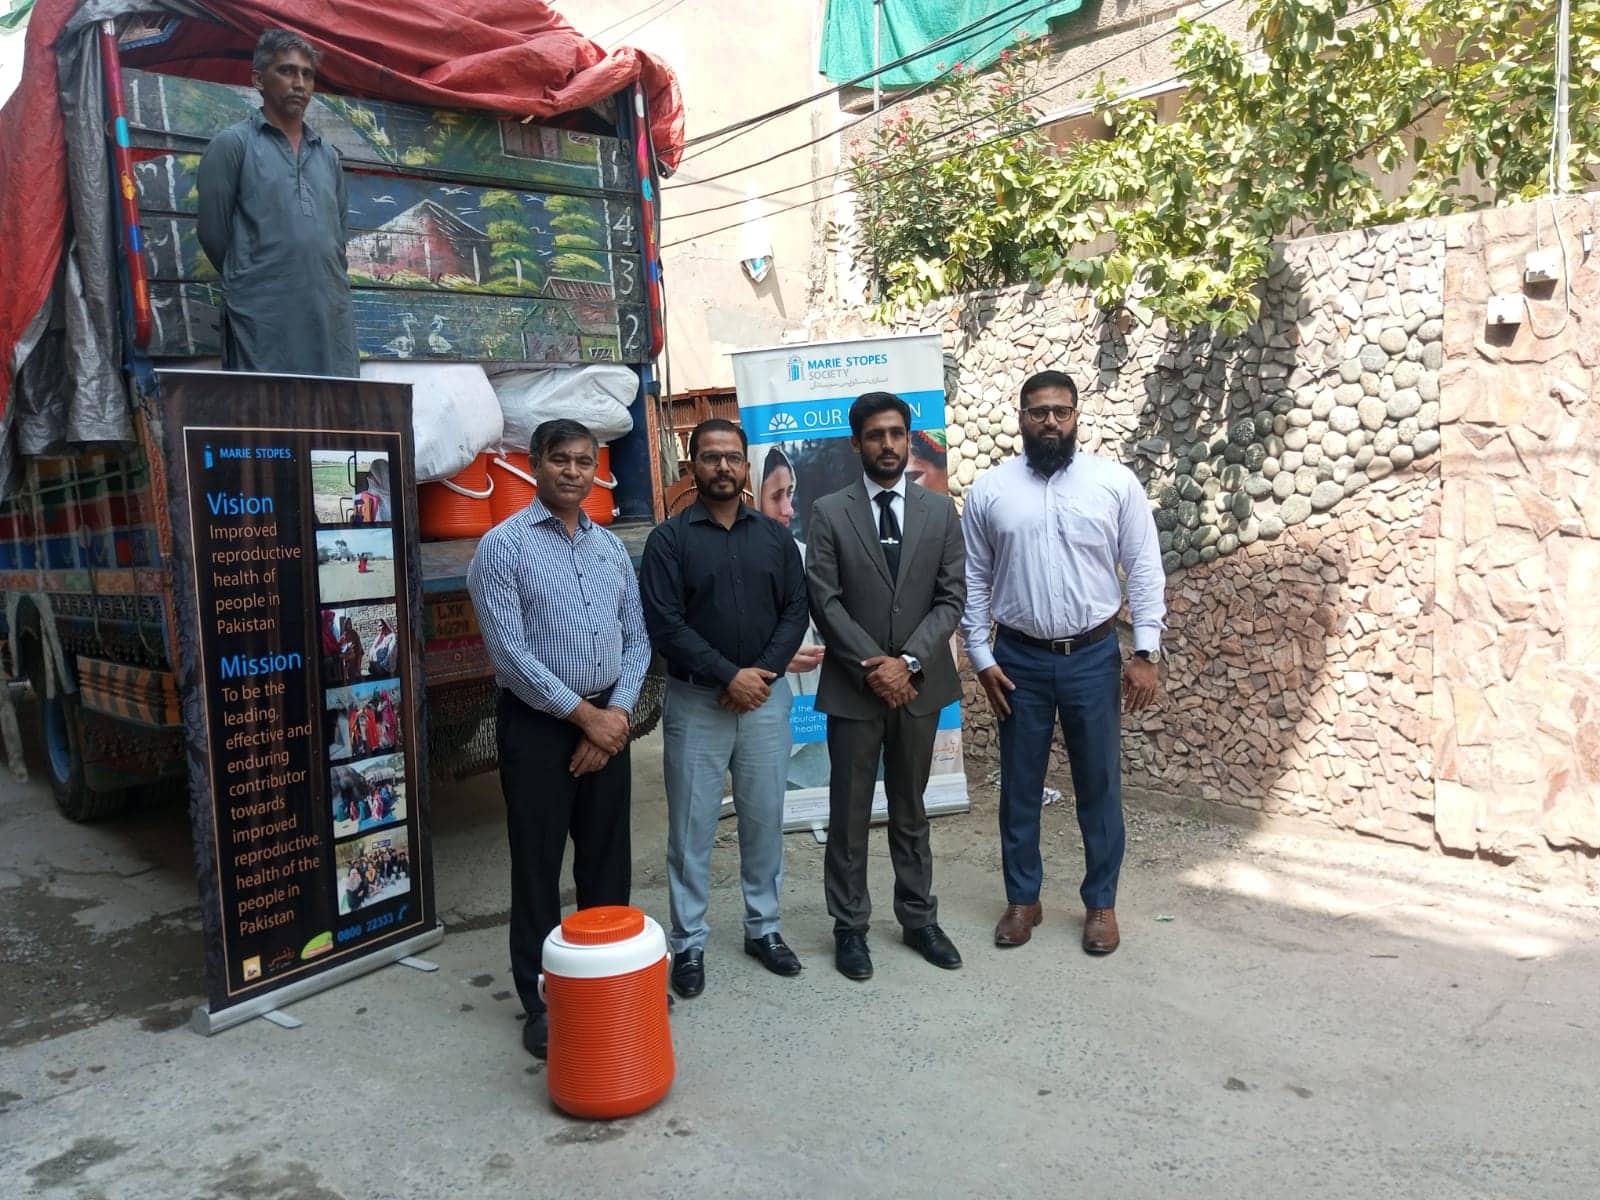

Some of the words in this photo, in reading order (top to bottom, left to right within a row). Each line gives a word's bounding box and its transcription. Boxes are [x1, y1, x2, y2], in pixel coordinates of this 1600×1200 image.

[612, 206, 635, 246] 4
[620, 258, 634, 295] 3
[625, 314, 640, 350] 2
[807, 357, 841, 370] MARIE
[846, 353, 888, 367] STOPES
[808, 368, 849, 380] SOCIETY
[803, 409, 843, 427] OUR
[219, 448, 252, 459] MARIE
[255, 448, 292, 459] STOPES
[206, 492, 274, 516] Vision
[210, 521, 278, 542] Improved
[211, 544, 302, 564] reproductive
[213, 570, 259, 588] health
[263, 568, 277, 585] of
[215, 594, 267, 615] people
[268, 592, 281, 607] in
[217, 617, 275, 635] Pakistan
[220, 651, 302, 680] Mission
[222, 687, 239, 703] To
[242, 684, 261, 700] be
[264, 680, 286, 697] the
[223, 706, 280, 727] leading,
[225, 725, 285, 750] effective
[287, 720, 313, 738] and
[227, 750, 290, 774] enduring
[228, 769, 307, 797] contributor
[230, 796, 286, 821] towards
[232, 815, 298, 844] improved
[234, 833, 320, 867] reproductive
[236, 866, 280, 890] health
[281, 860, 298, 877] of
[298, 854, 321, 873] the
[238, 889, 285, 917] people
[287, 884, 301, 898] in
[239, 908, 296, 937] Pakistan
[336, 925, 363, 943] 0800
